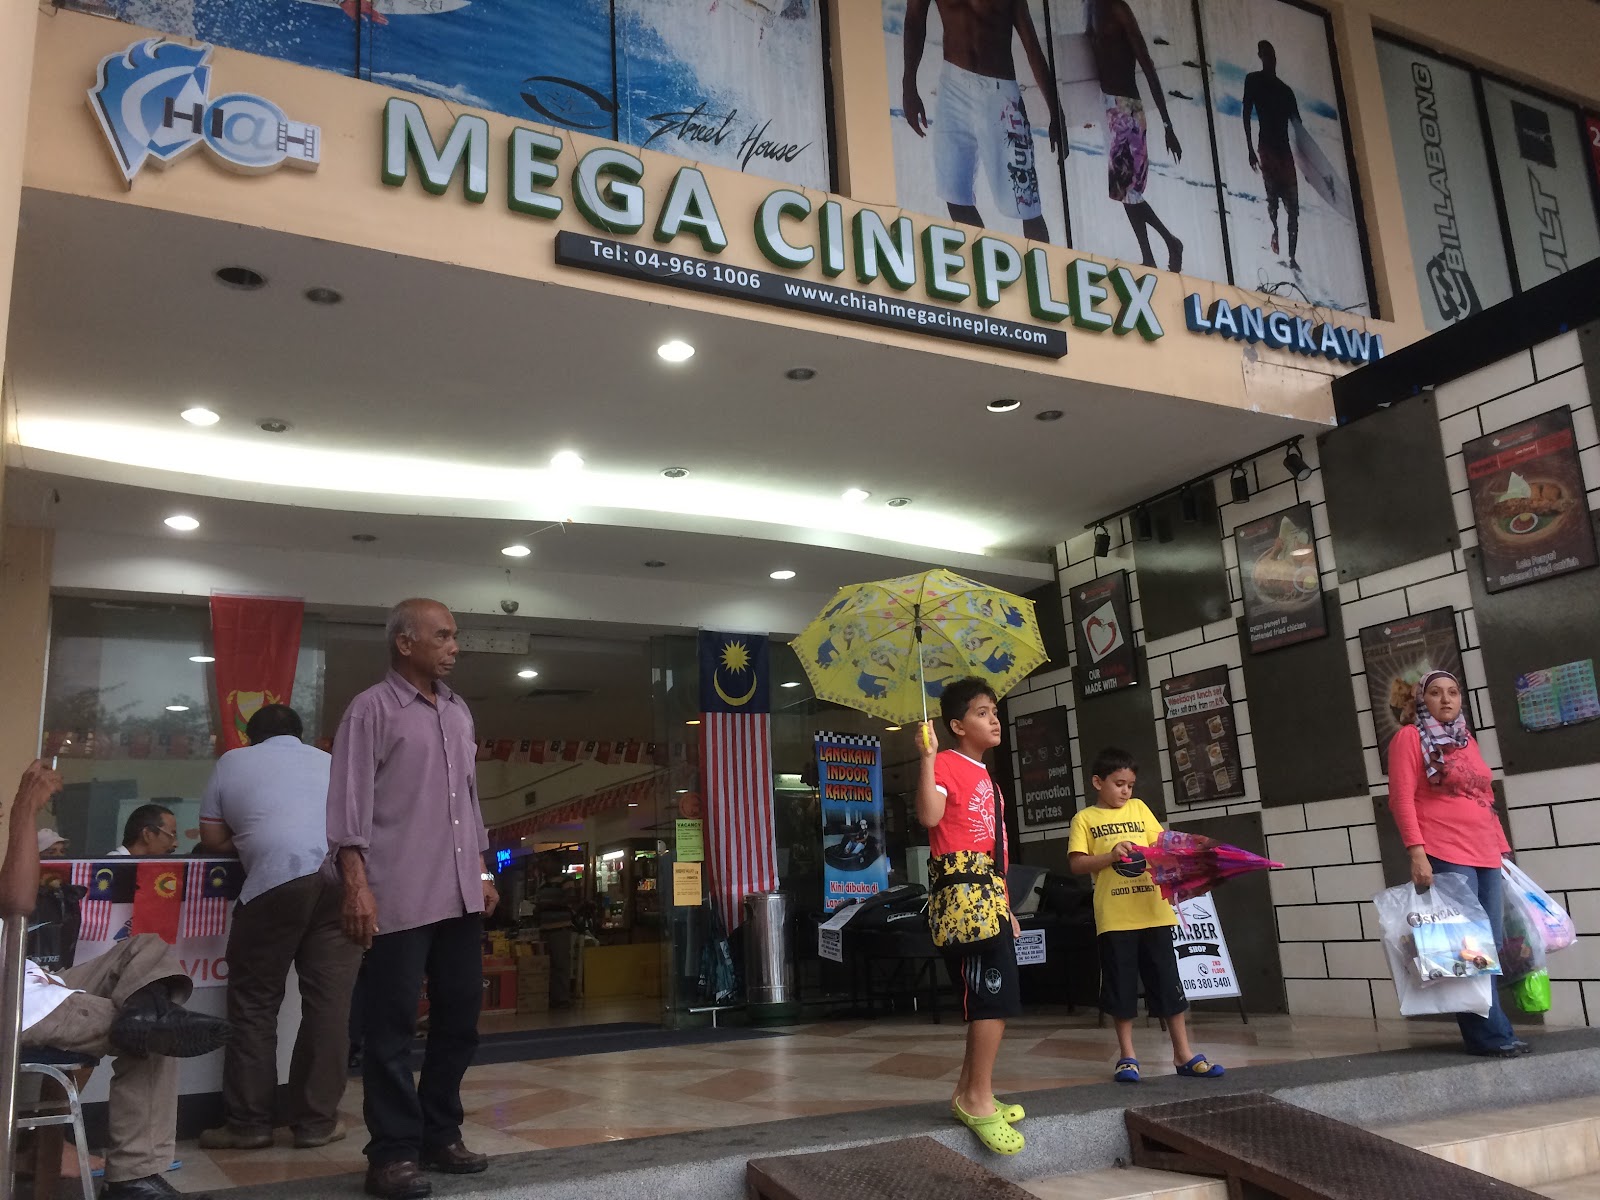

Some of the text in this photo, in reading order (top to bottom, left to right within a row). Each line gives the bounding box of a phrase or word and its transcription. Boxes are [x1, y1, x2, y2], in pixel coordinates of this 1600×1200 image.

[641, 102, 738, 149] Street
[737, 119, 813, 172] House
[1412, 62, 1466, 273] BILLABONG
[381, 97, 1165, 342] MEGA CINEPLEX
[590, 240, 1048, 346] Tel: 04-966 1006 www.chiahmegacineplex.com
[1184, 293, 1386, 365] LANGKAWI
[1089, 669, 1101, 681] OUR
[1084, 681, 1102, 696] MADE
[1102, 677, 1118, 692] WITH
[819, 746, 876, 765] LANGKAWI
[827, 765, 869, 783] INDOOR
[825, 783, 873, 802] KARTING
[1025, 786, 1071, 805] promotion
[1035, 805, 1062, 821] prizes
[830, 881, 879, 894] Kini dibuka di
[1111, 888, 1130, 896] GOOD
[1019, 936, 1039, 944] DANGER
[1188, 945, 1207, 954] SHOP
[1183, 979, 1197, 990] 016
[1198, 977, 1213, 990] 380
